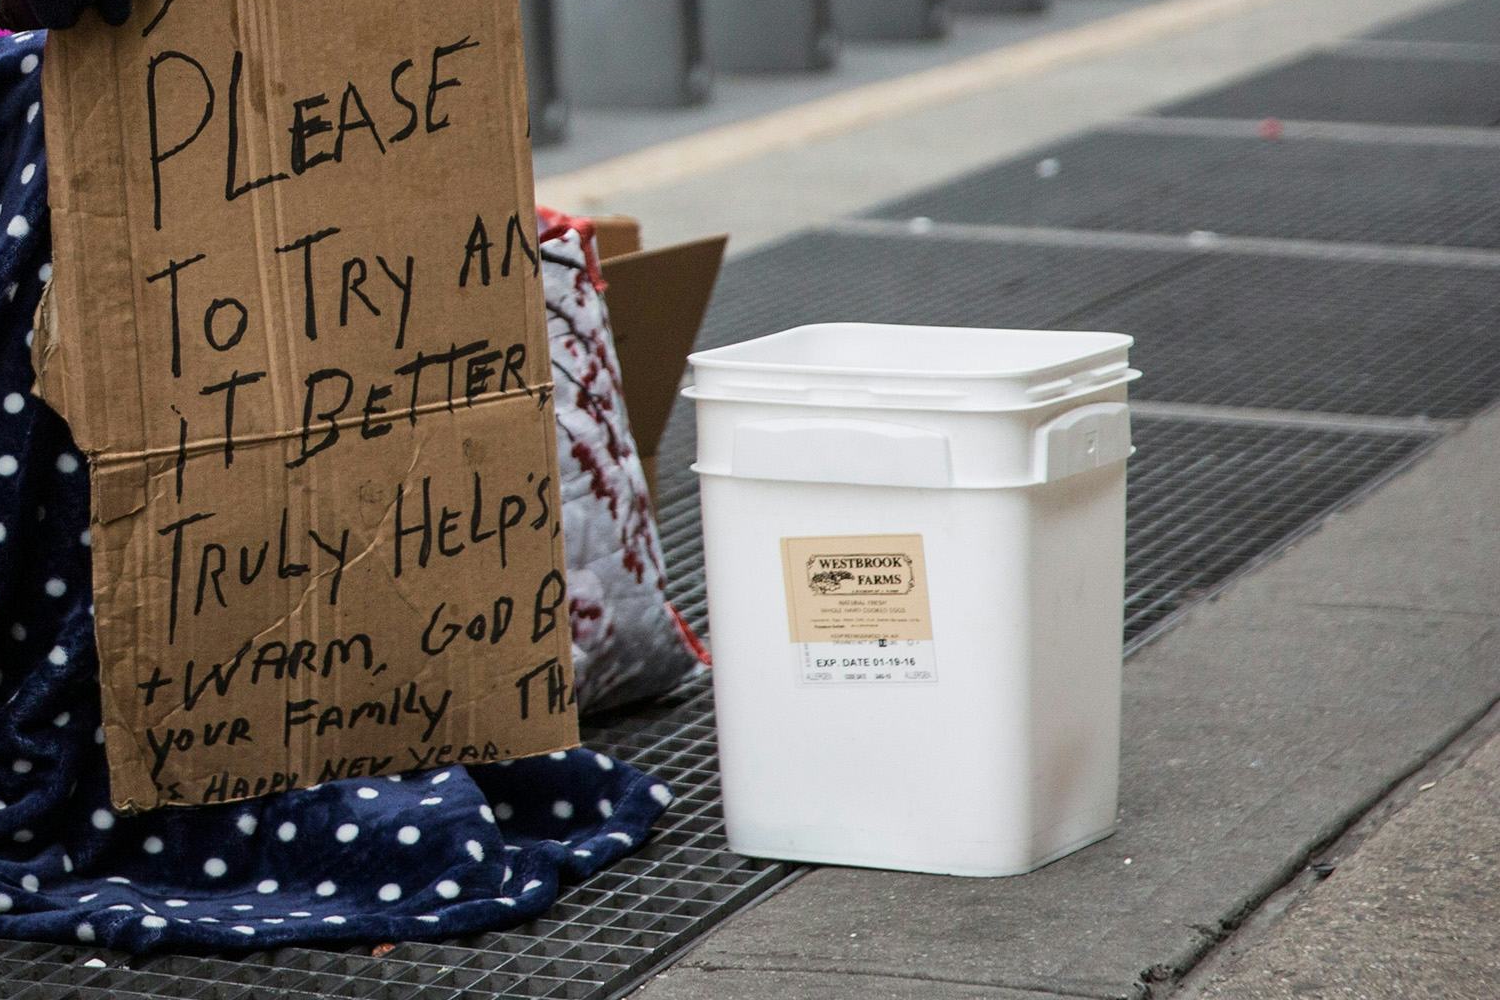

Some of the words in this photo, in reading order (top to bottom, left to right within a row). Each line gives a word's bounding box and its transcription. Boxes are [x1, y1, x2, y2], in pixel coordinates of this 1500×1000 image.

[146, 36, 481, 231] PLEASE
[146, 253, 247, 378] TO
[274, 226, 415, 349] TRY
[157, 507, 350, 645] TRULY
[818, 556, 903, 570] WESTBROOK
[856, 573, 903, 586] FARMS
[842, 657, 871, 668] DATE
